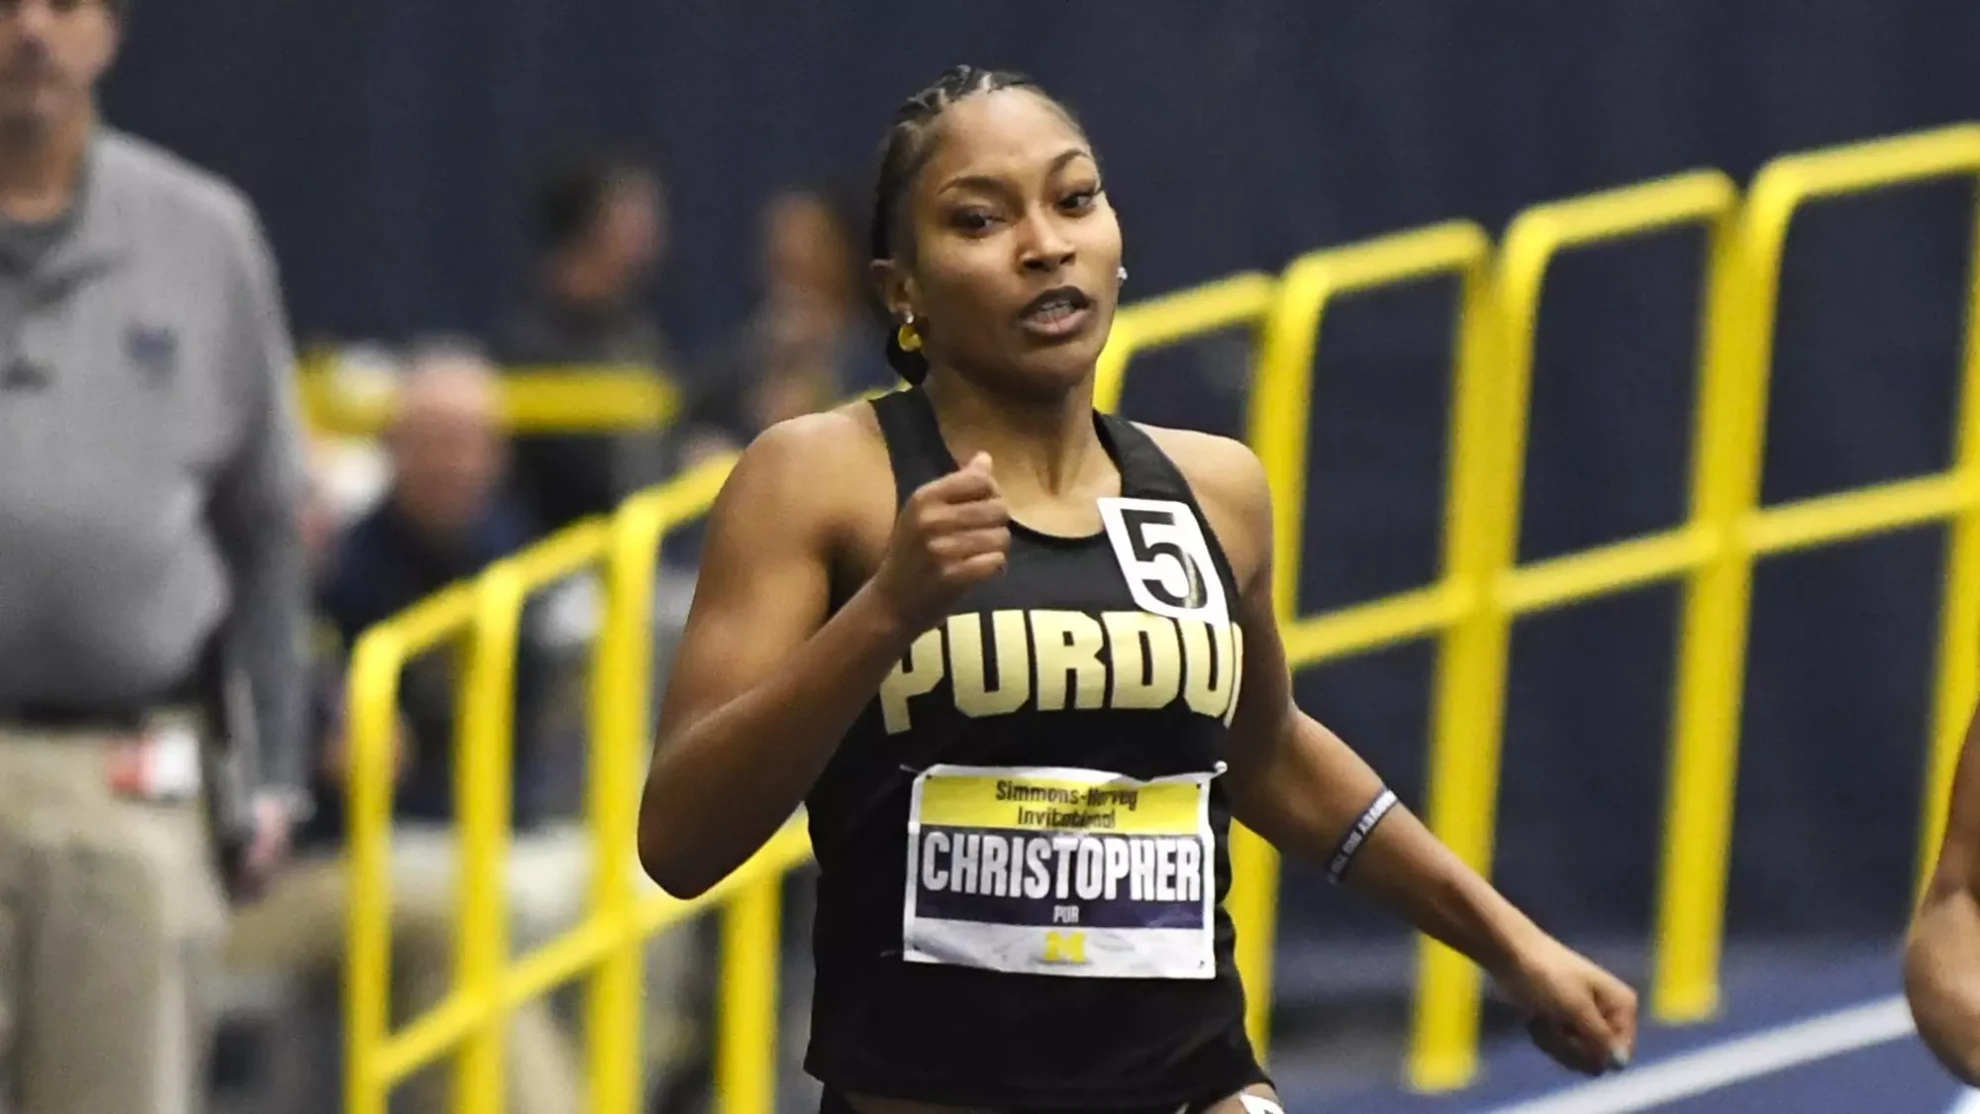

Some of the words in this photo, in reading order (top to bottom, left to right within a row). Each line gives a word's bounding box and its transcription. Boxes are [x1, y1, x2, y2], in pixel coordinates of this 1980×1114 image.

[1120, 508, 1208, 610] 5
[879, 608, 1244, 736] PURDU
[921, 831, 1202, 903] CHRISTOPHER
[1043, 930, 1088, 964] M
[1053, 904, 1079, 924] PUR
